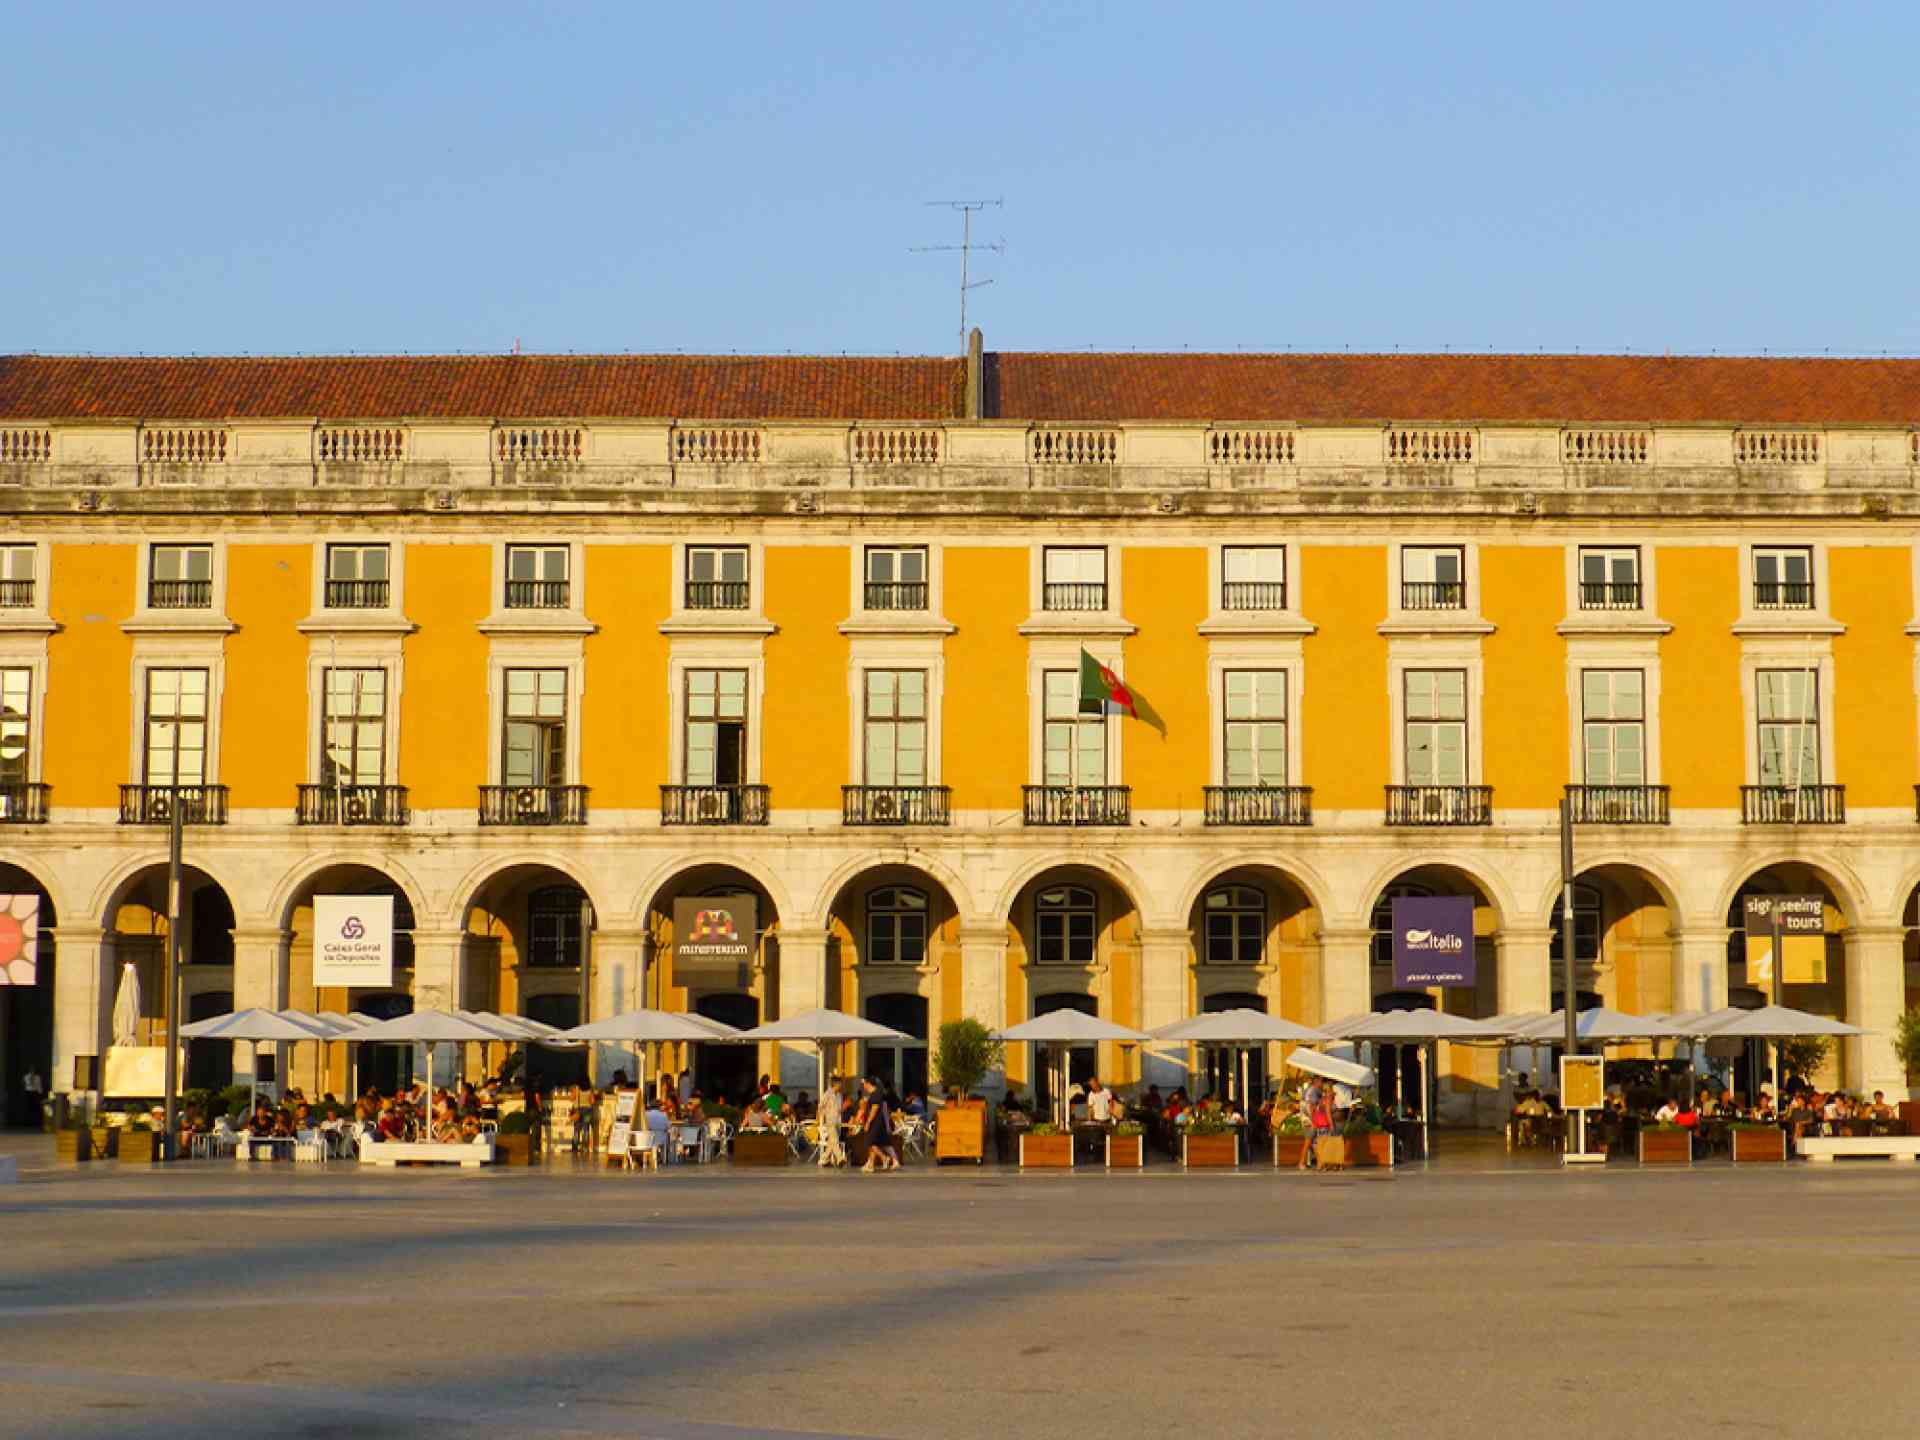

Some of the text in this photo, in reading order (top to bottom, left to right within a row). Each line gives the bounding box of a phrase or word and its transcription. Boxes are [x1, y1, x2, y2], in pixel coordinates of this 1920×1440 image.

[1786, 916, 1822, 929] tours
[324, 943, 381, 953] Caixa Geral
